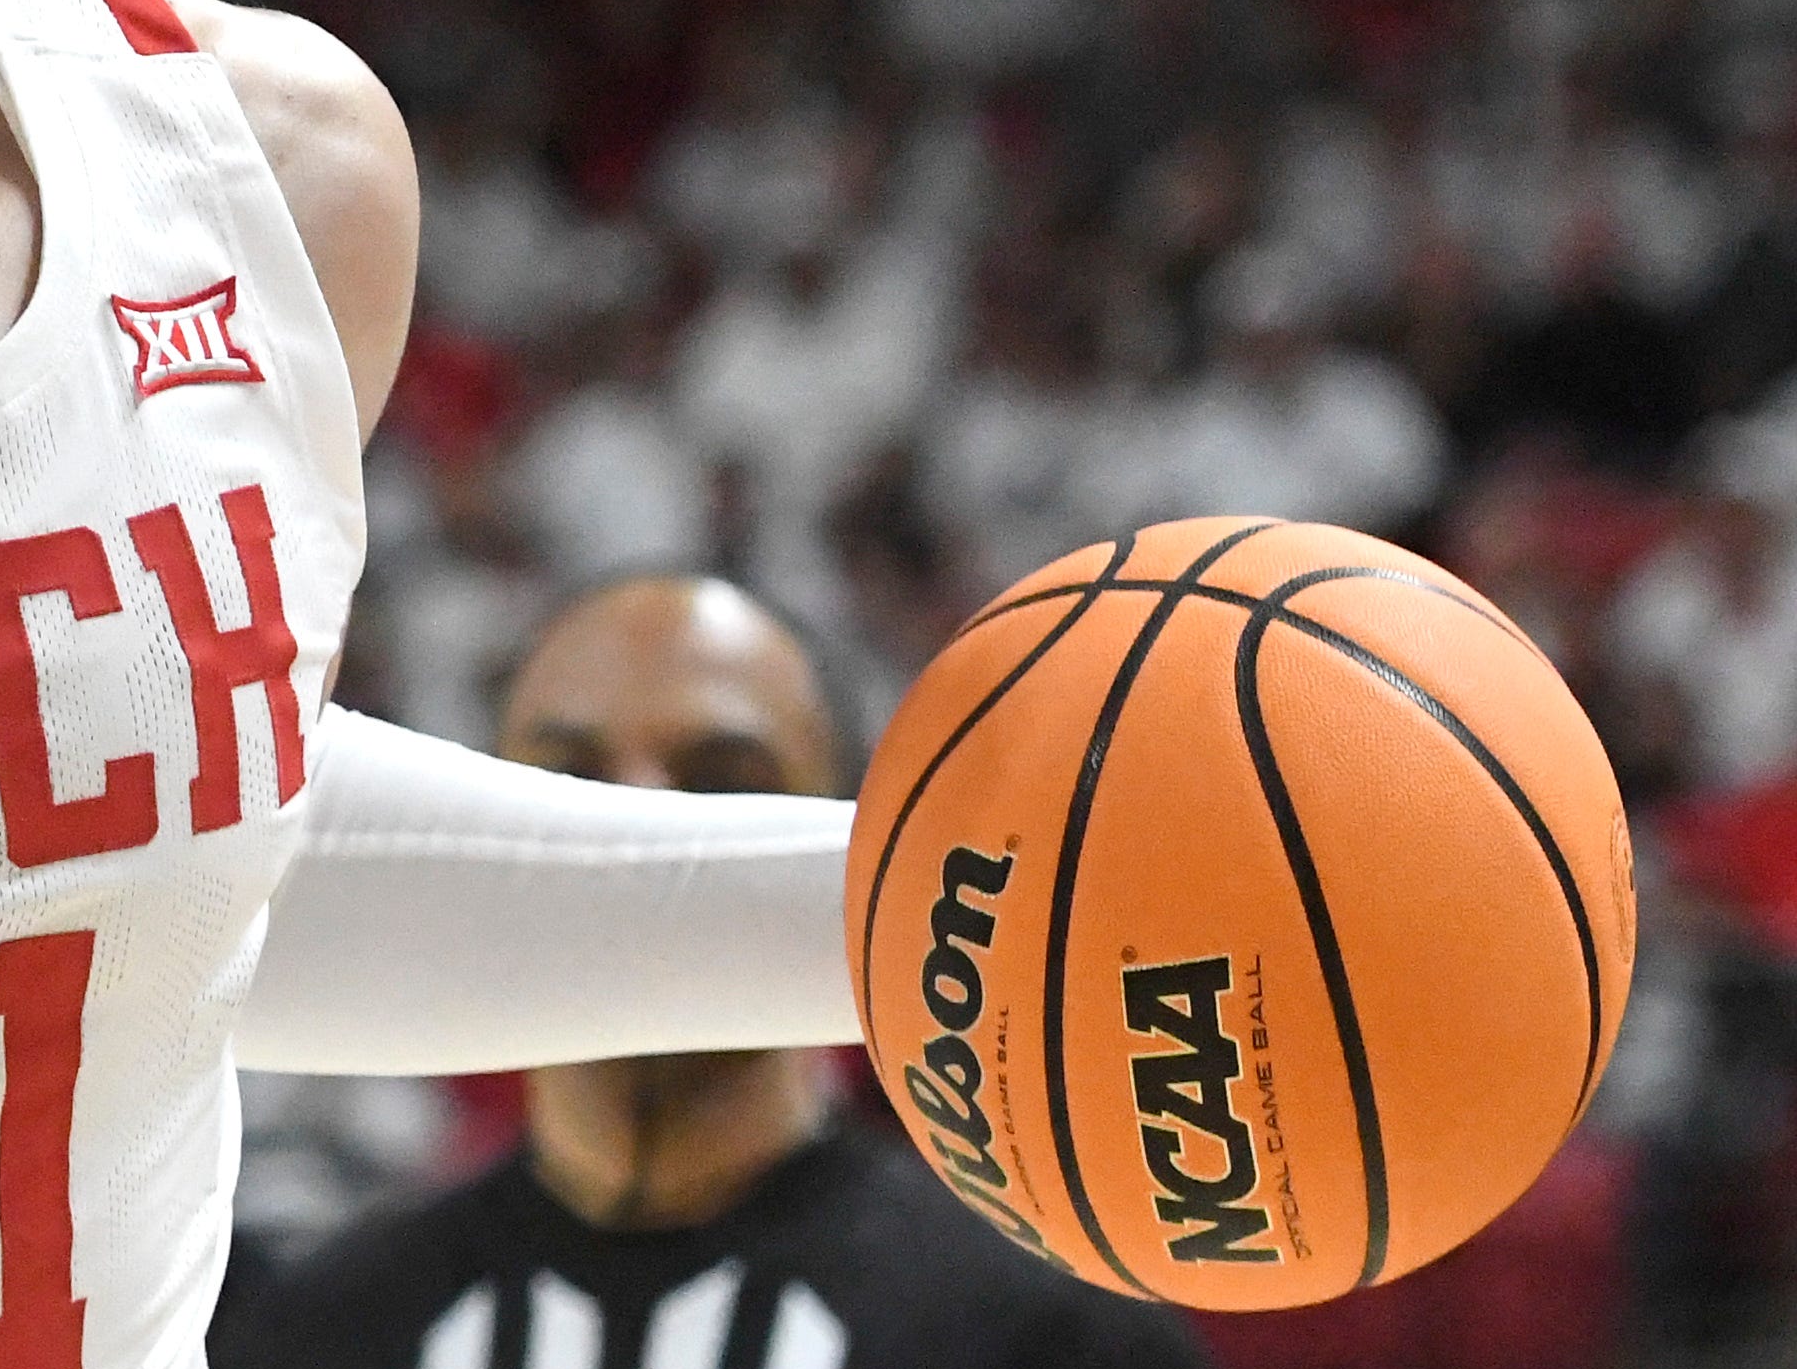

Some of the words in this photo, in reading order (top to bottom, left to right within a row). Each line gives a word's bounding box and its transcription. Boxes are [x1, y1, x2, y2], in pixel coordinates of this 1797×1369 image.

[119, 291, 249, 385] XII
[1245, 953, 1270, 1050] BALL
[1120, 953, 1283, 1264] NCAA
